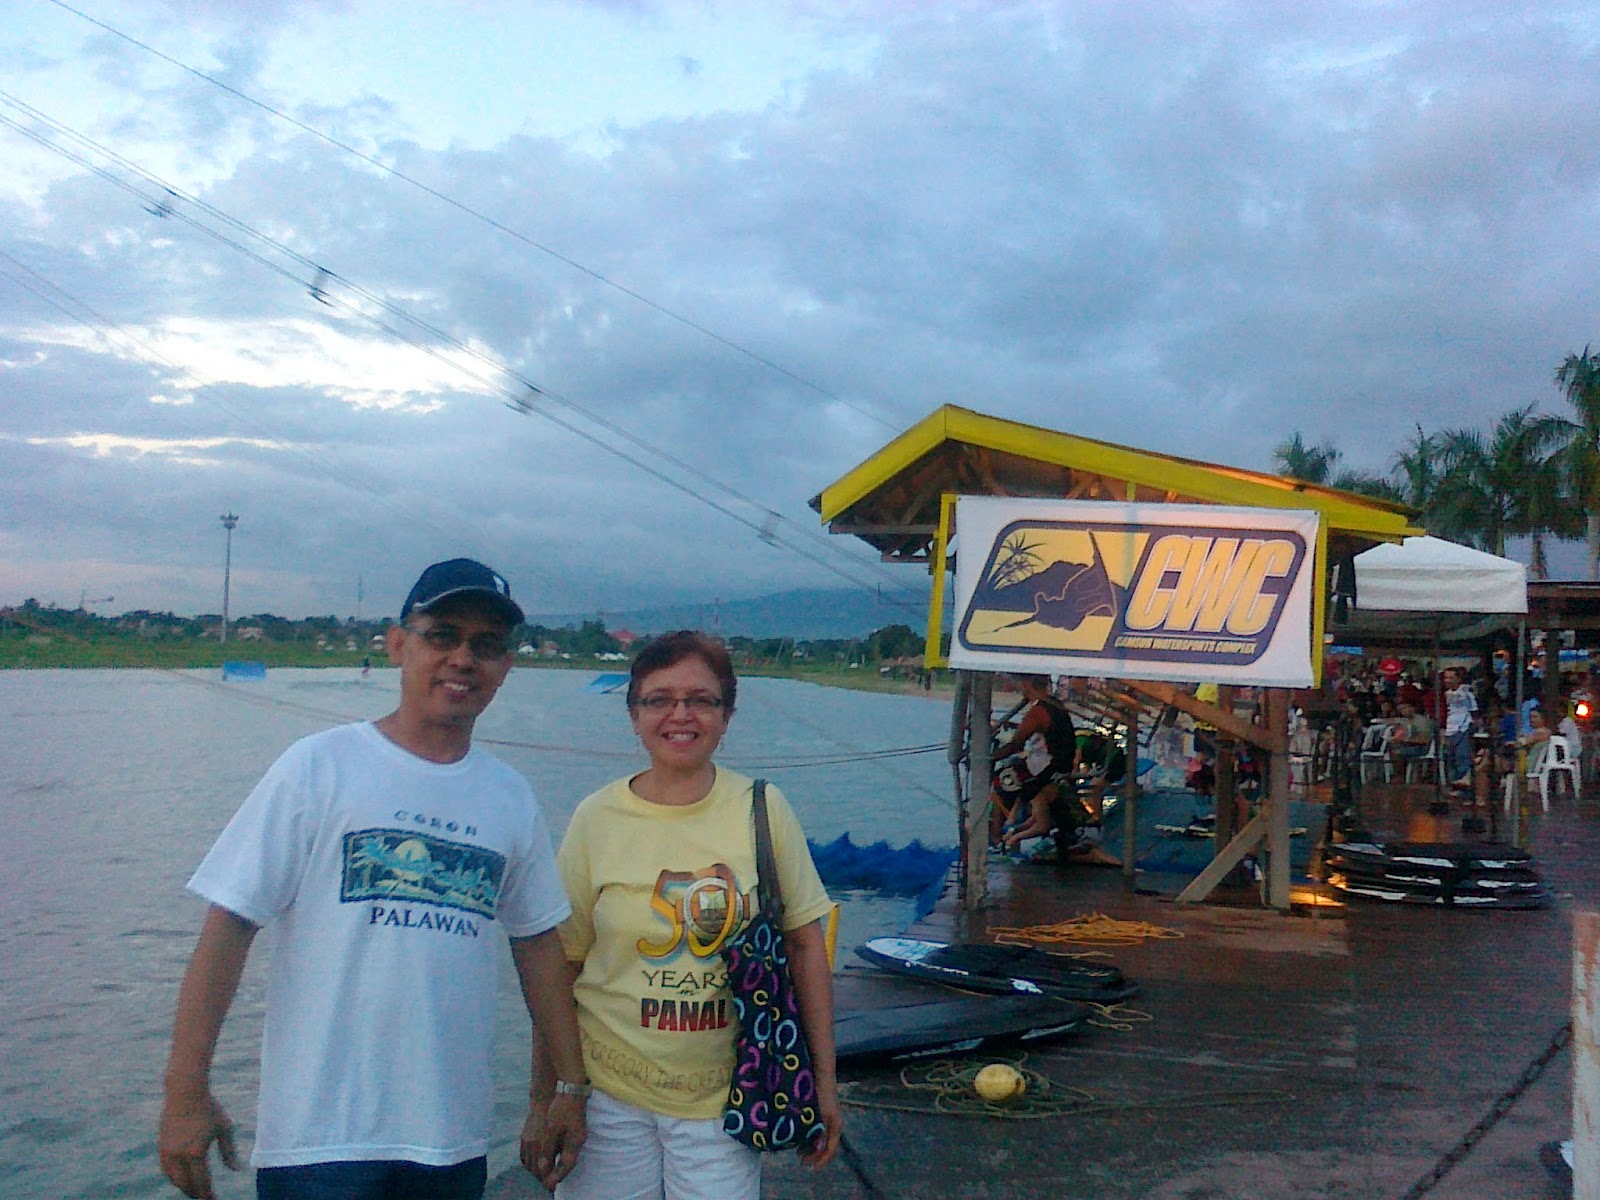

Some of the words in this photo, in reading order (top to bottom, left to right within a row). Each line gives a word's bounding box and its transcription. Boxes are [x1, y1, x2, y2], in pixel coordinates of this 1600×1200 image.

[1125, 534, 1297, 636] CWC
[1214, 641, 1258, 655] COMPLEX
[369, 905, 480, 938] PALAWAN
[636, 863, 737, 958] 50
